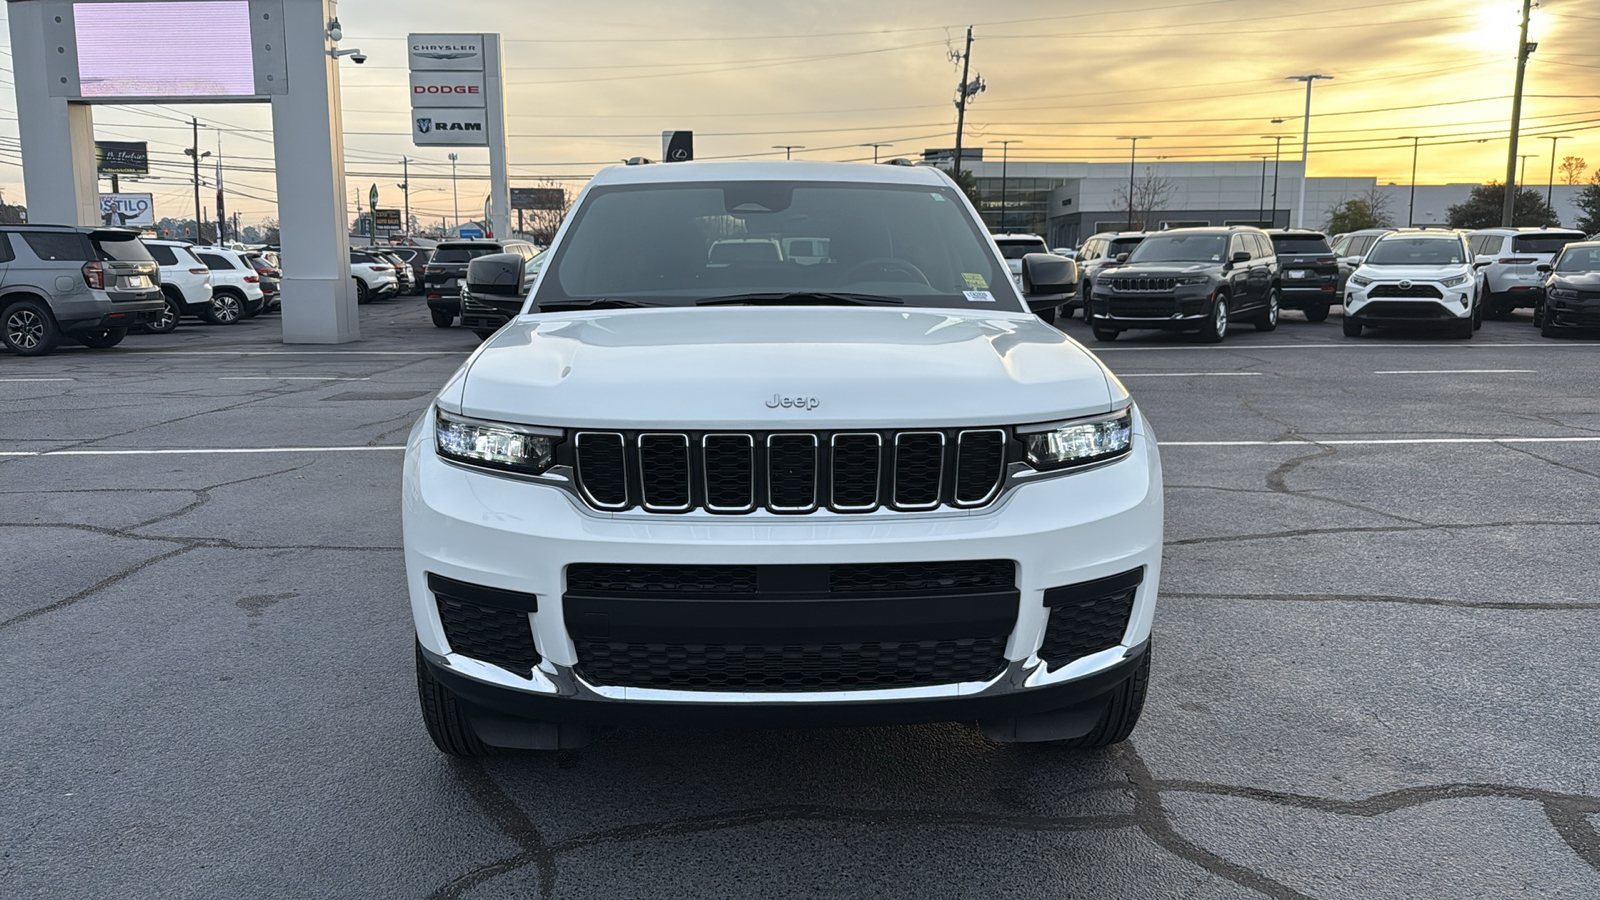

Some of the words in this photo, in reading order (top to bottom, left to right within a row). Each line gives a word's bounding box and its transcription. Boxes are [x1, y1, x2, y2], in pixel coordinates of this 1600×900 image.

[413, 86, 480, 94] DODGE
[435, 122, 482, 131] RAM
[765, 393, 820, 411] Jeep
